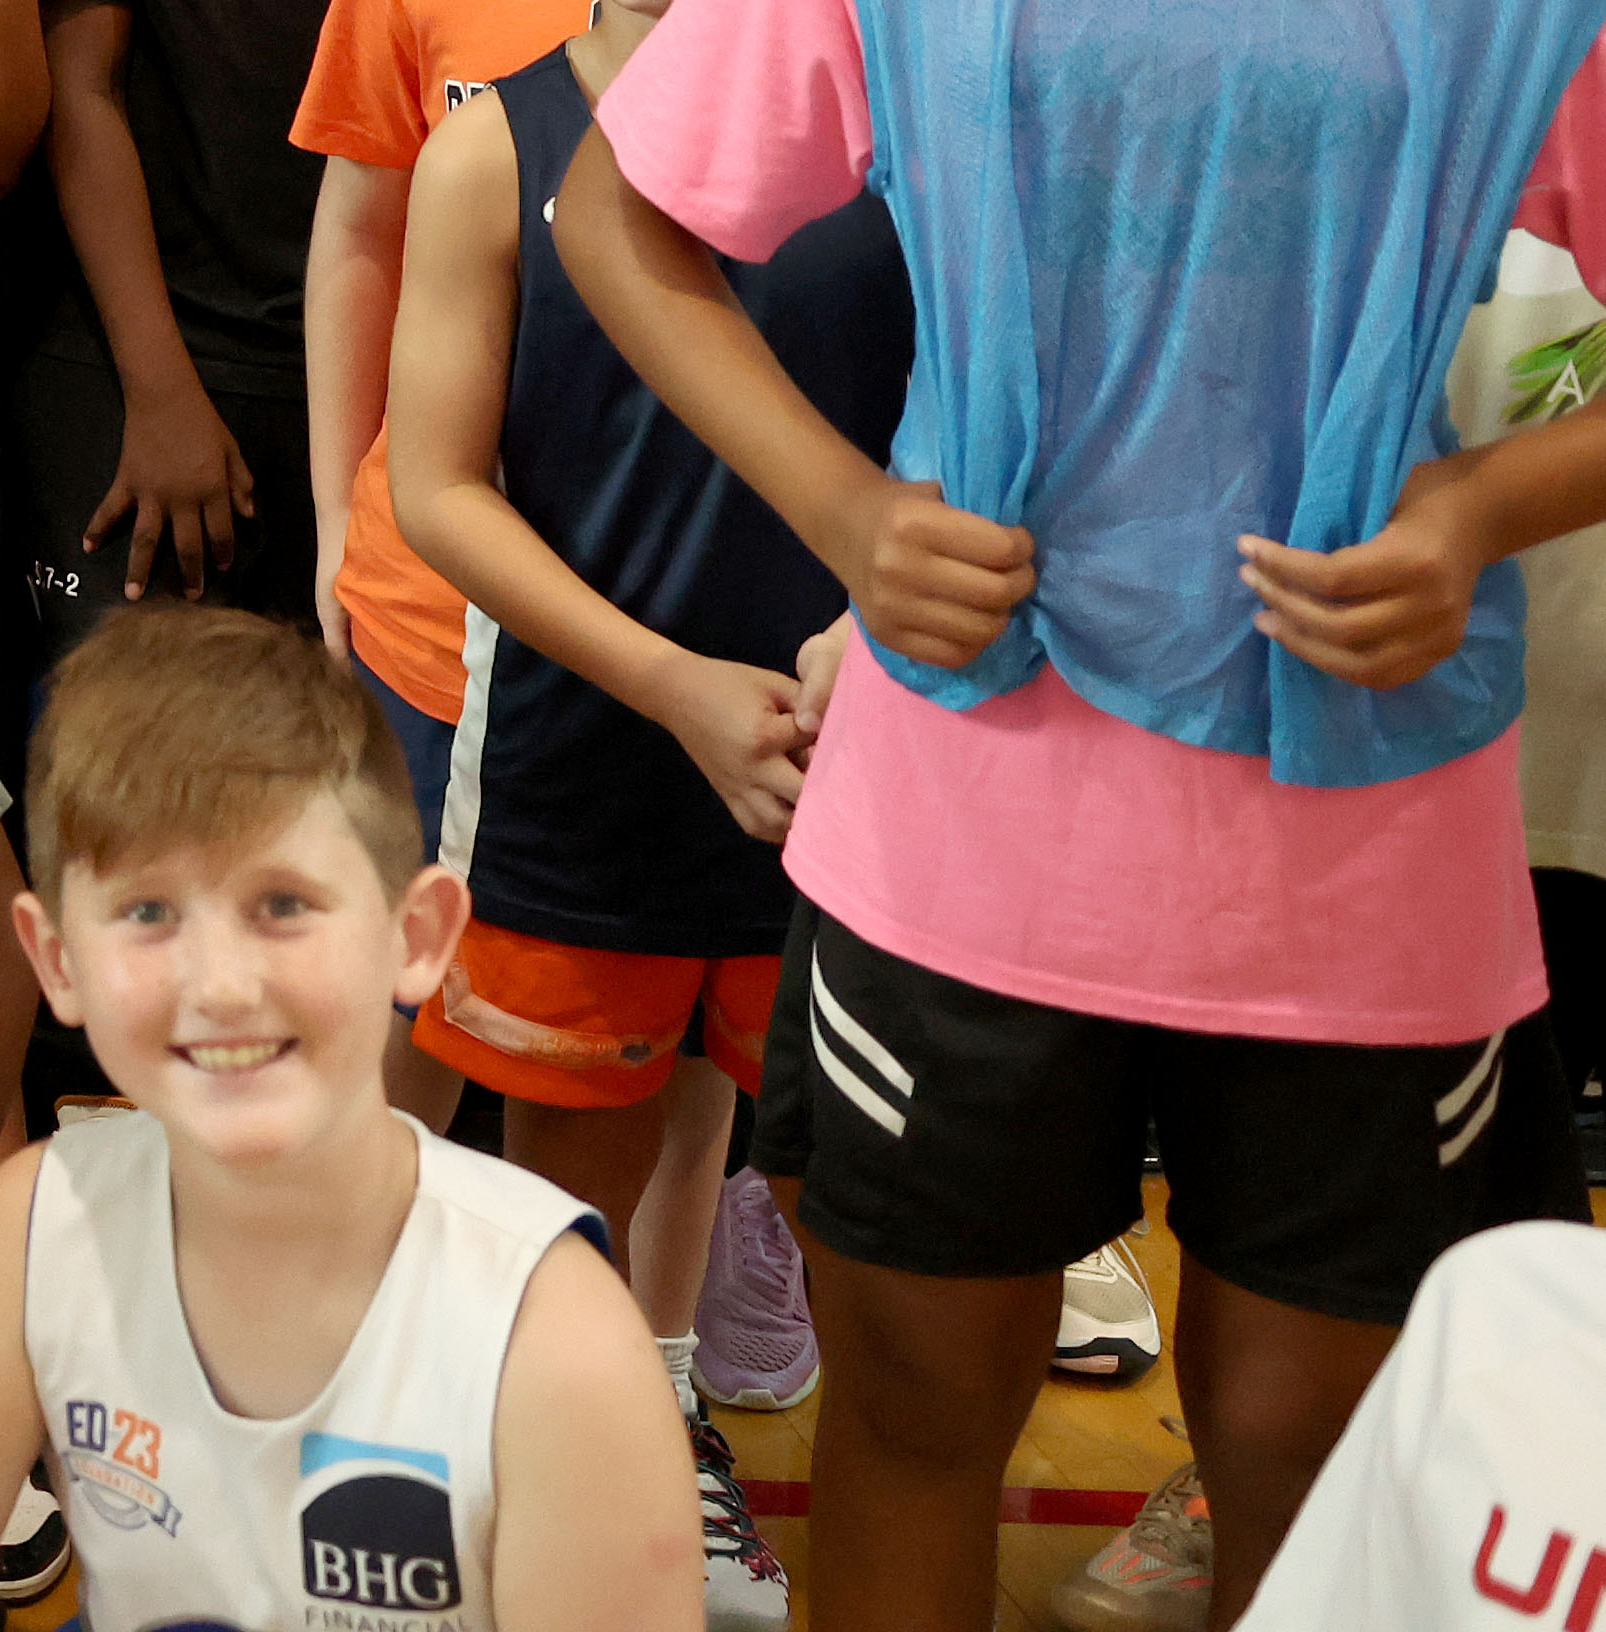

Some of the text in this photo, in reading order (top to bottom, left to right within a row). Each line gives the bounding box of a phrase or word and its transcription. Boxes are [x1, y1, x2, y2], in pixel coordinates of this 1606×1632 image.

[65, 1400, 162, 1480] ED 23
[308, 1538, 451, 1610] BHG
